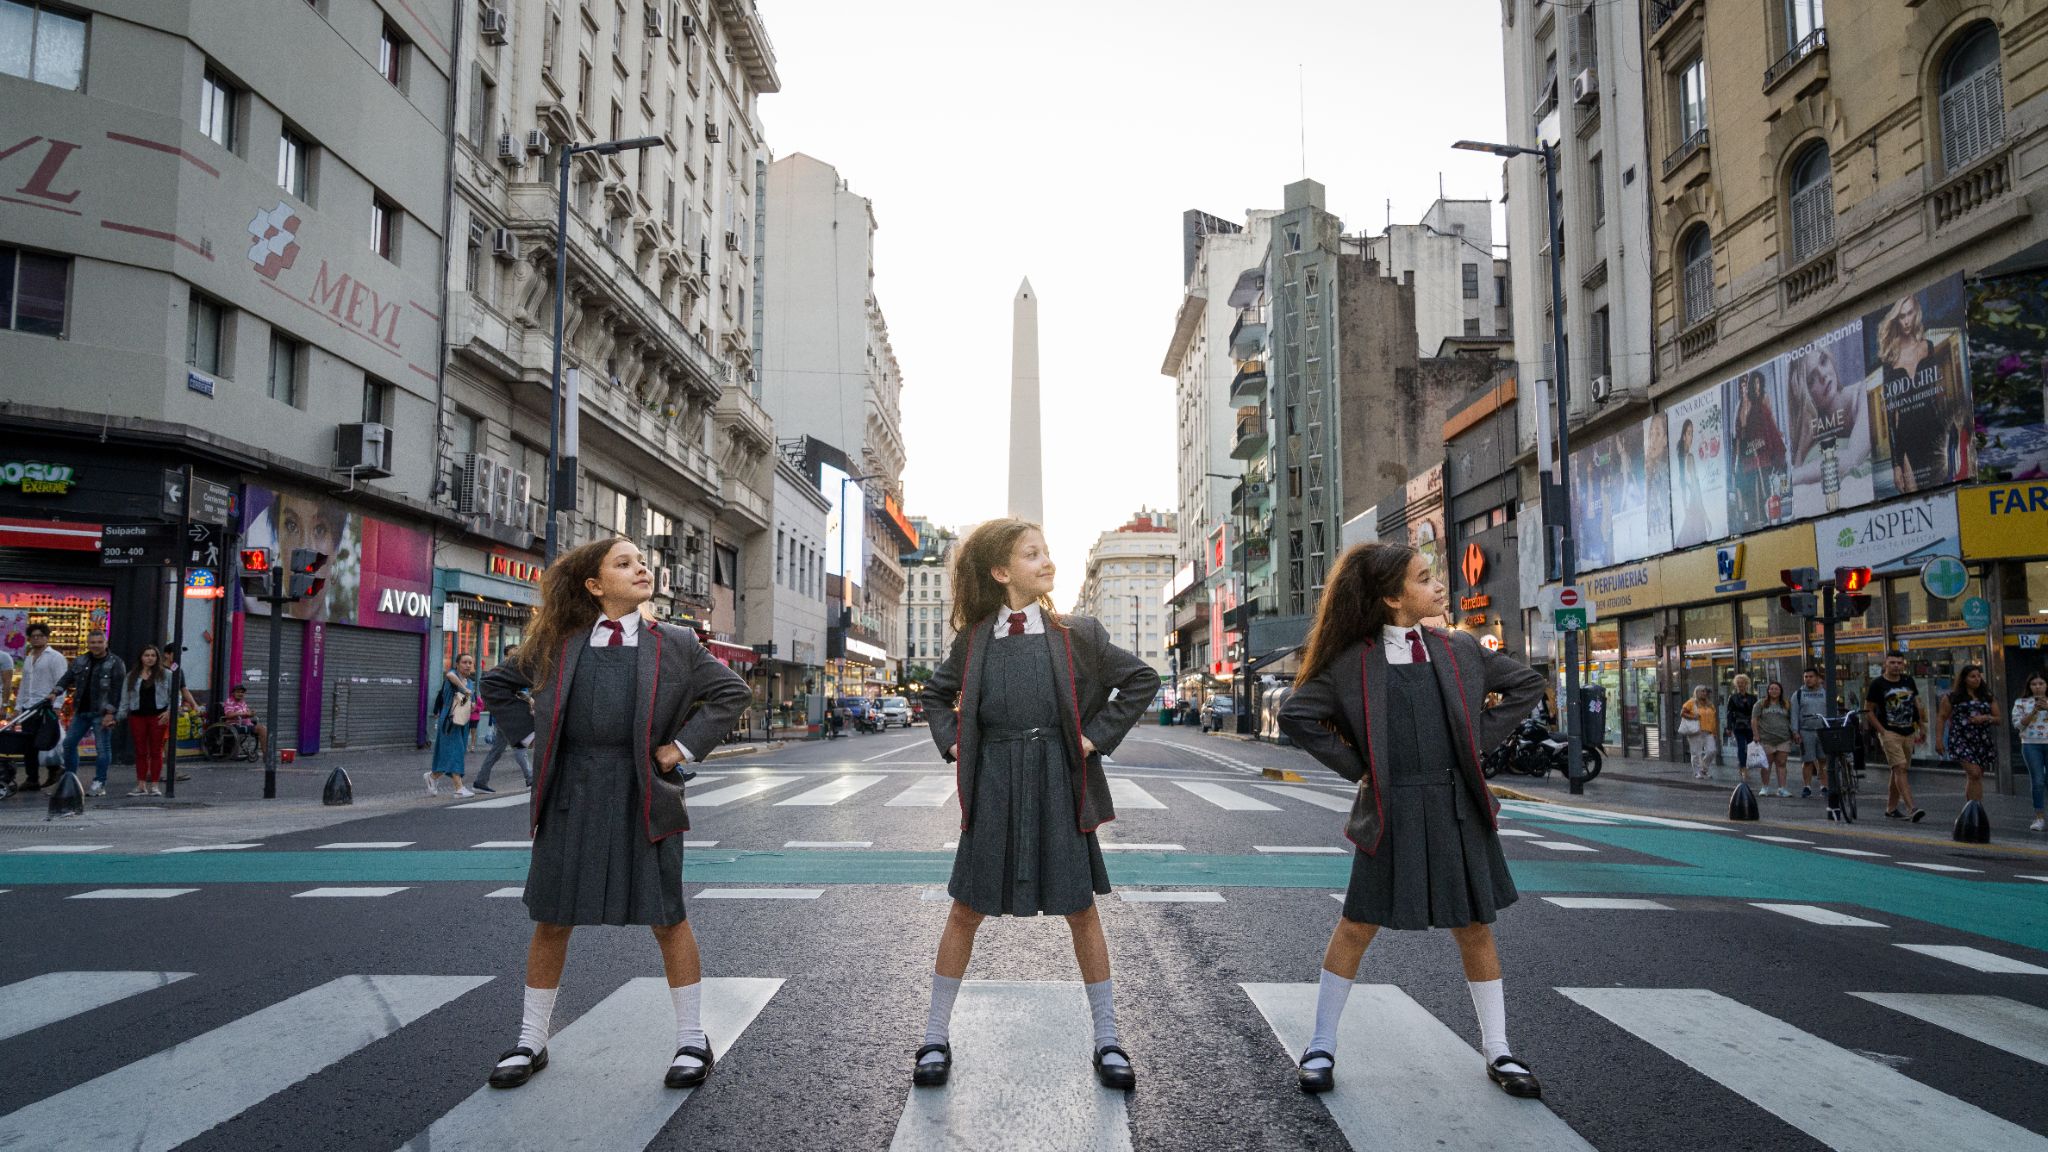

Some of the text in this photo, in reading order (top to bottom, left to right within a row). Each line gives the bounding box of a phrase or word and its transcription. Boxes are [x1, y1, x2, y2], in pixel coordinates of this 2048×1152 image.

[309, 259, 403, 350] MEYL
[1812, 319, 1863, 352] rabanne
[1881, 365, 1944, 400] GOOD GIRL
[1693, 391, 1714, 410] RICCI
[1810, 409, 1845, 434] FAME
[1989, 486, 2048, 515] FAR
[105, 526, 146, 537] Suipacha
[1858, 503, 1934, 545] ASPEN
[104, 547, 121, 556] 300
[127, 547, 144, 556] 400
[1587, 567, 1649, 596] Y PERFUMERIAS
[378, 588, 431, 618] AVON
